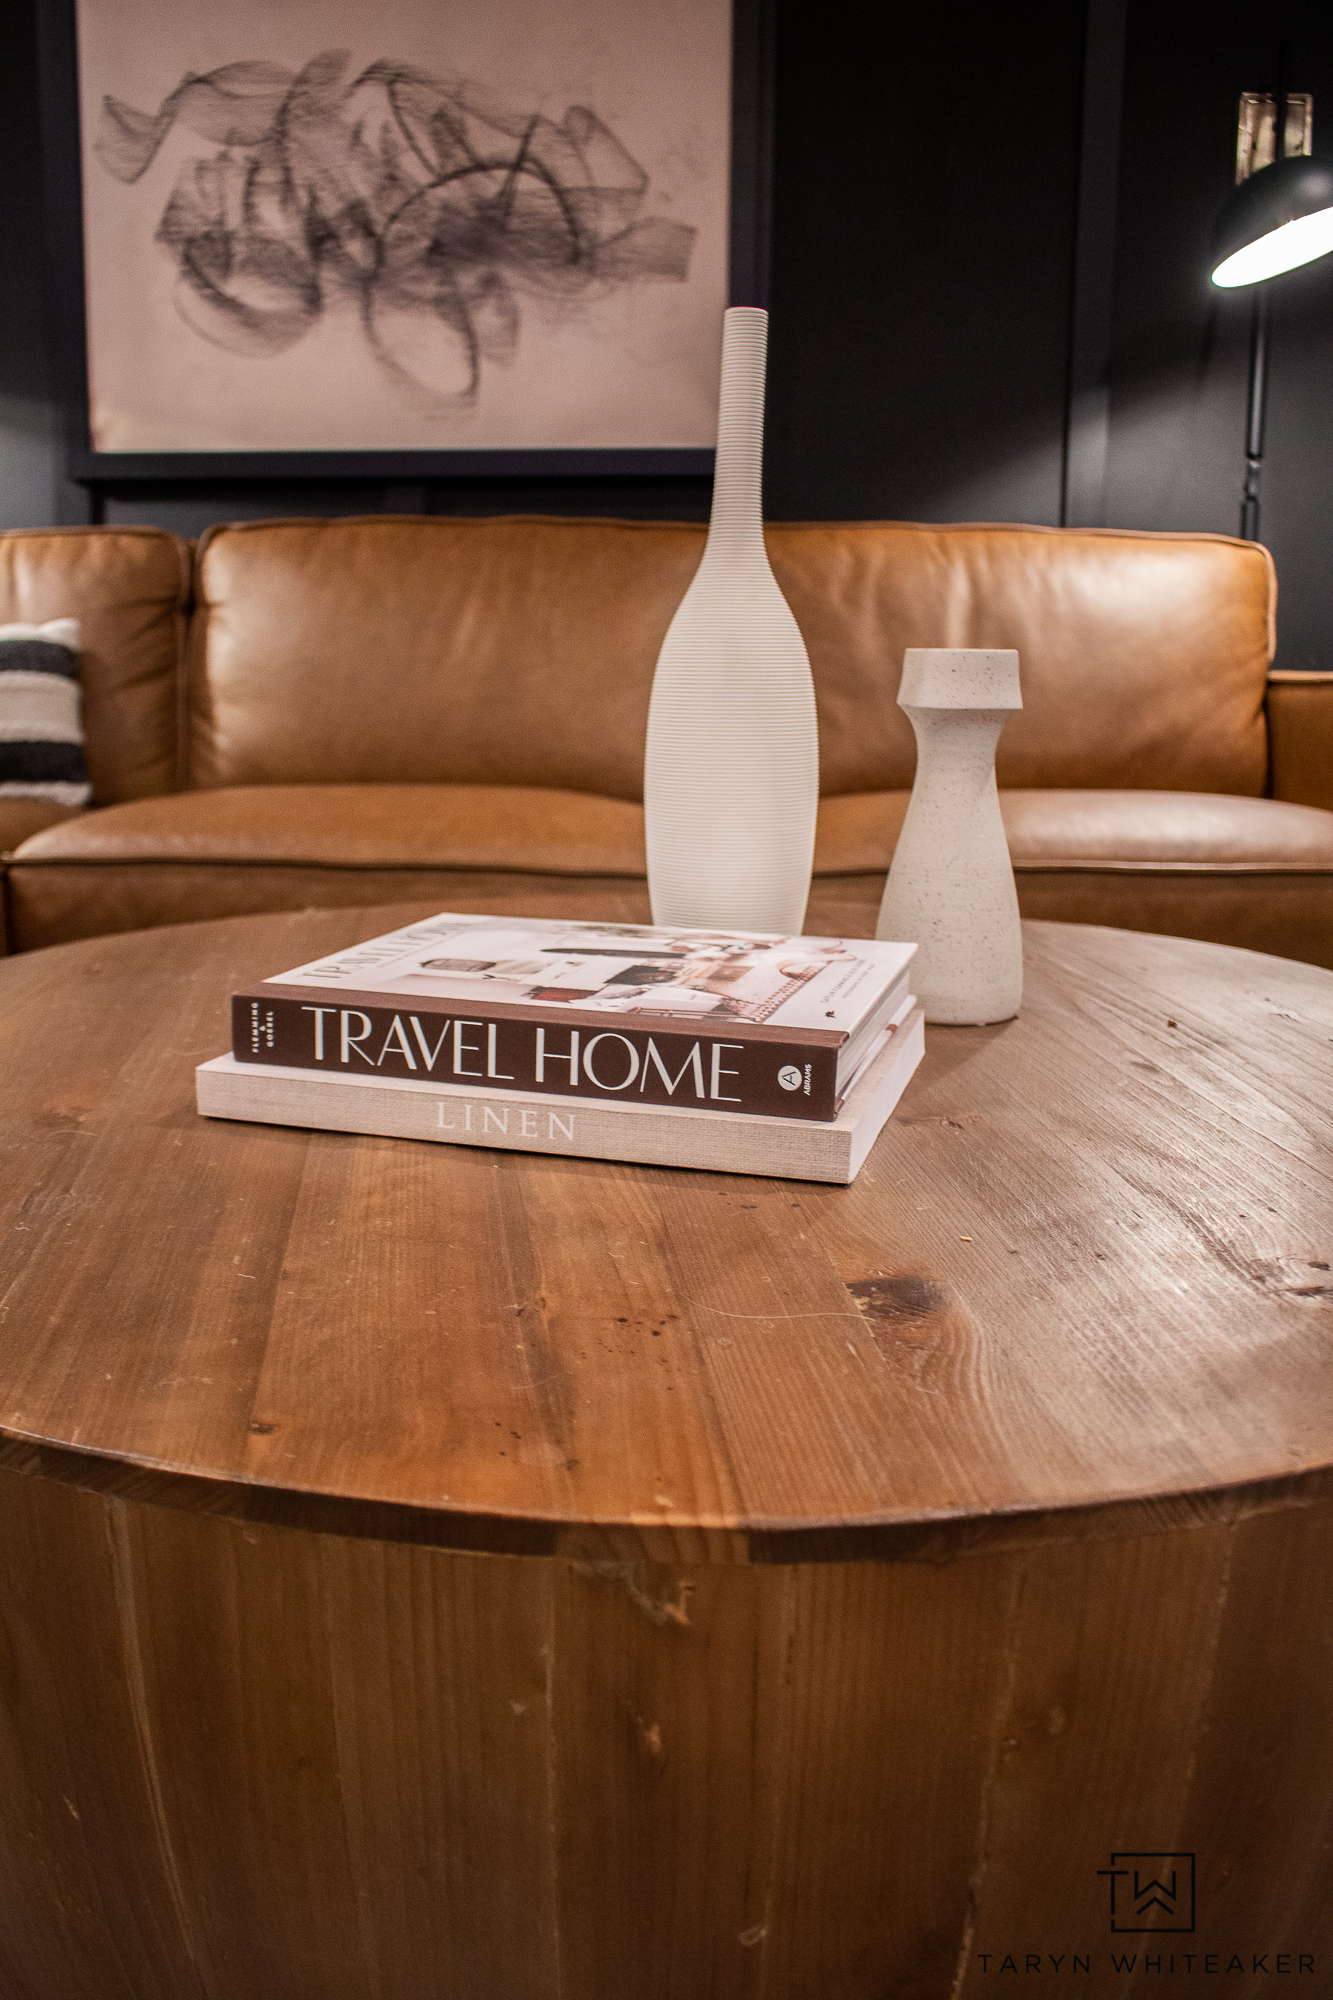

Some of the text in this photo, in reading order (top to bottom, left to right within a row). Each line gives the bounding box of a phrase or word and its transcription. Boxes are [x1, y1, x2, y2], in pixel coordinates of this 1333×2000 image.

[251, 1002, 259, 1053] FLEMMING
[302, 1006, 744, 1102] TRAVEL HOME
[803, 1063, 812, 1096] ABRAMS
[434, 1101, 576, 1141] LINEN
